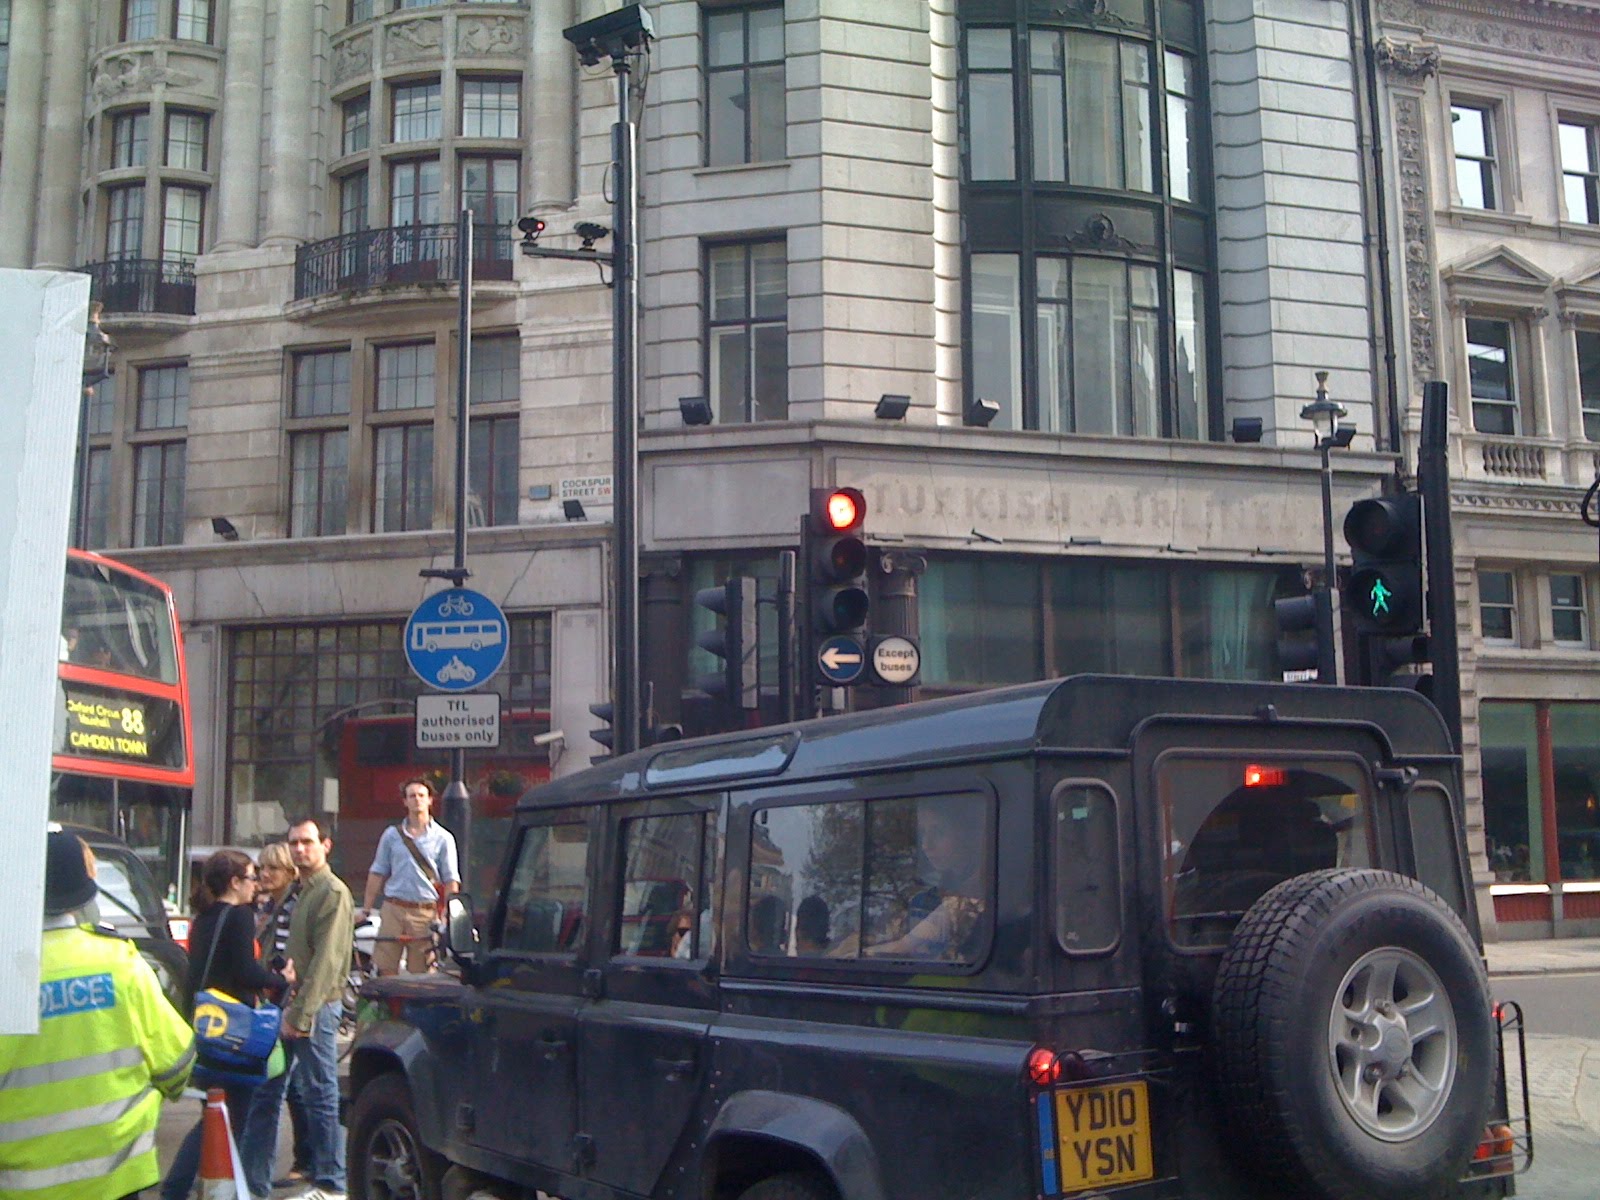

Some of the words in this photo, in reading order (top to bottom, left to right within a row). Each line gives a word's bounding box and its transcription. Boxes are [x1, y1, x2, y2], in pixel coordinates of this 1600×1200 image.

[562, 477, 611, 489] COCKSPUR
[562, 488, 594, 498] STREET
[878, 648, 914, 659] Except
[881, 662, 912, 671] buses
[447, 700, 469, 712] TfL
[121, 707, 144, 734] 88
[422, 714, 494, 727] authorised
[421, 731, 460, 741] buses
[465, 730, 494, 743] only
[70, 731, 115, 751] CAMDEN
[116, 737, 147, 756] TOWN
[1066, 1088, 1136, 1133] YD10
[1074, 1134, 1135, 1179] YSN
